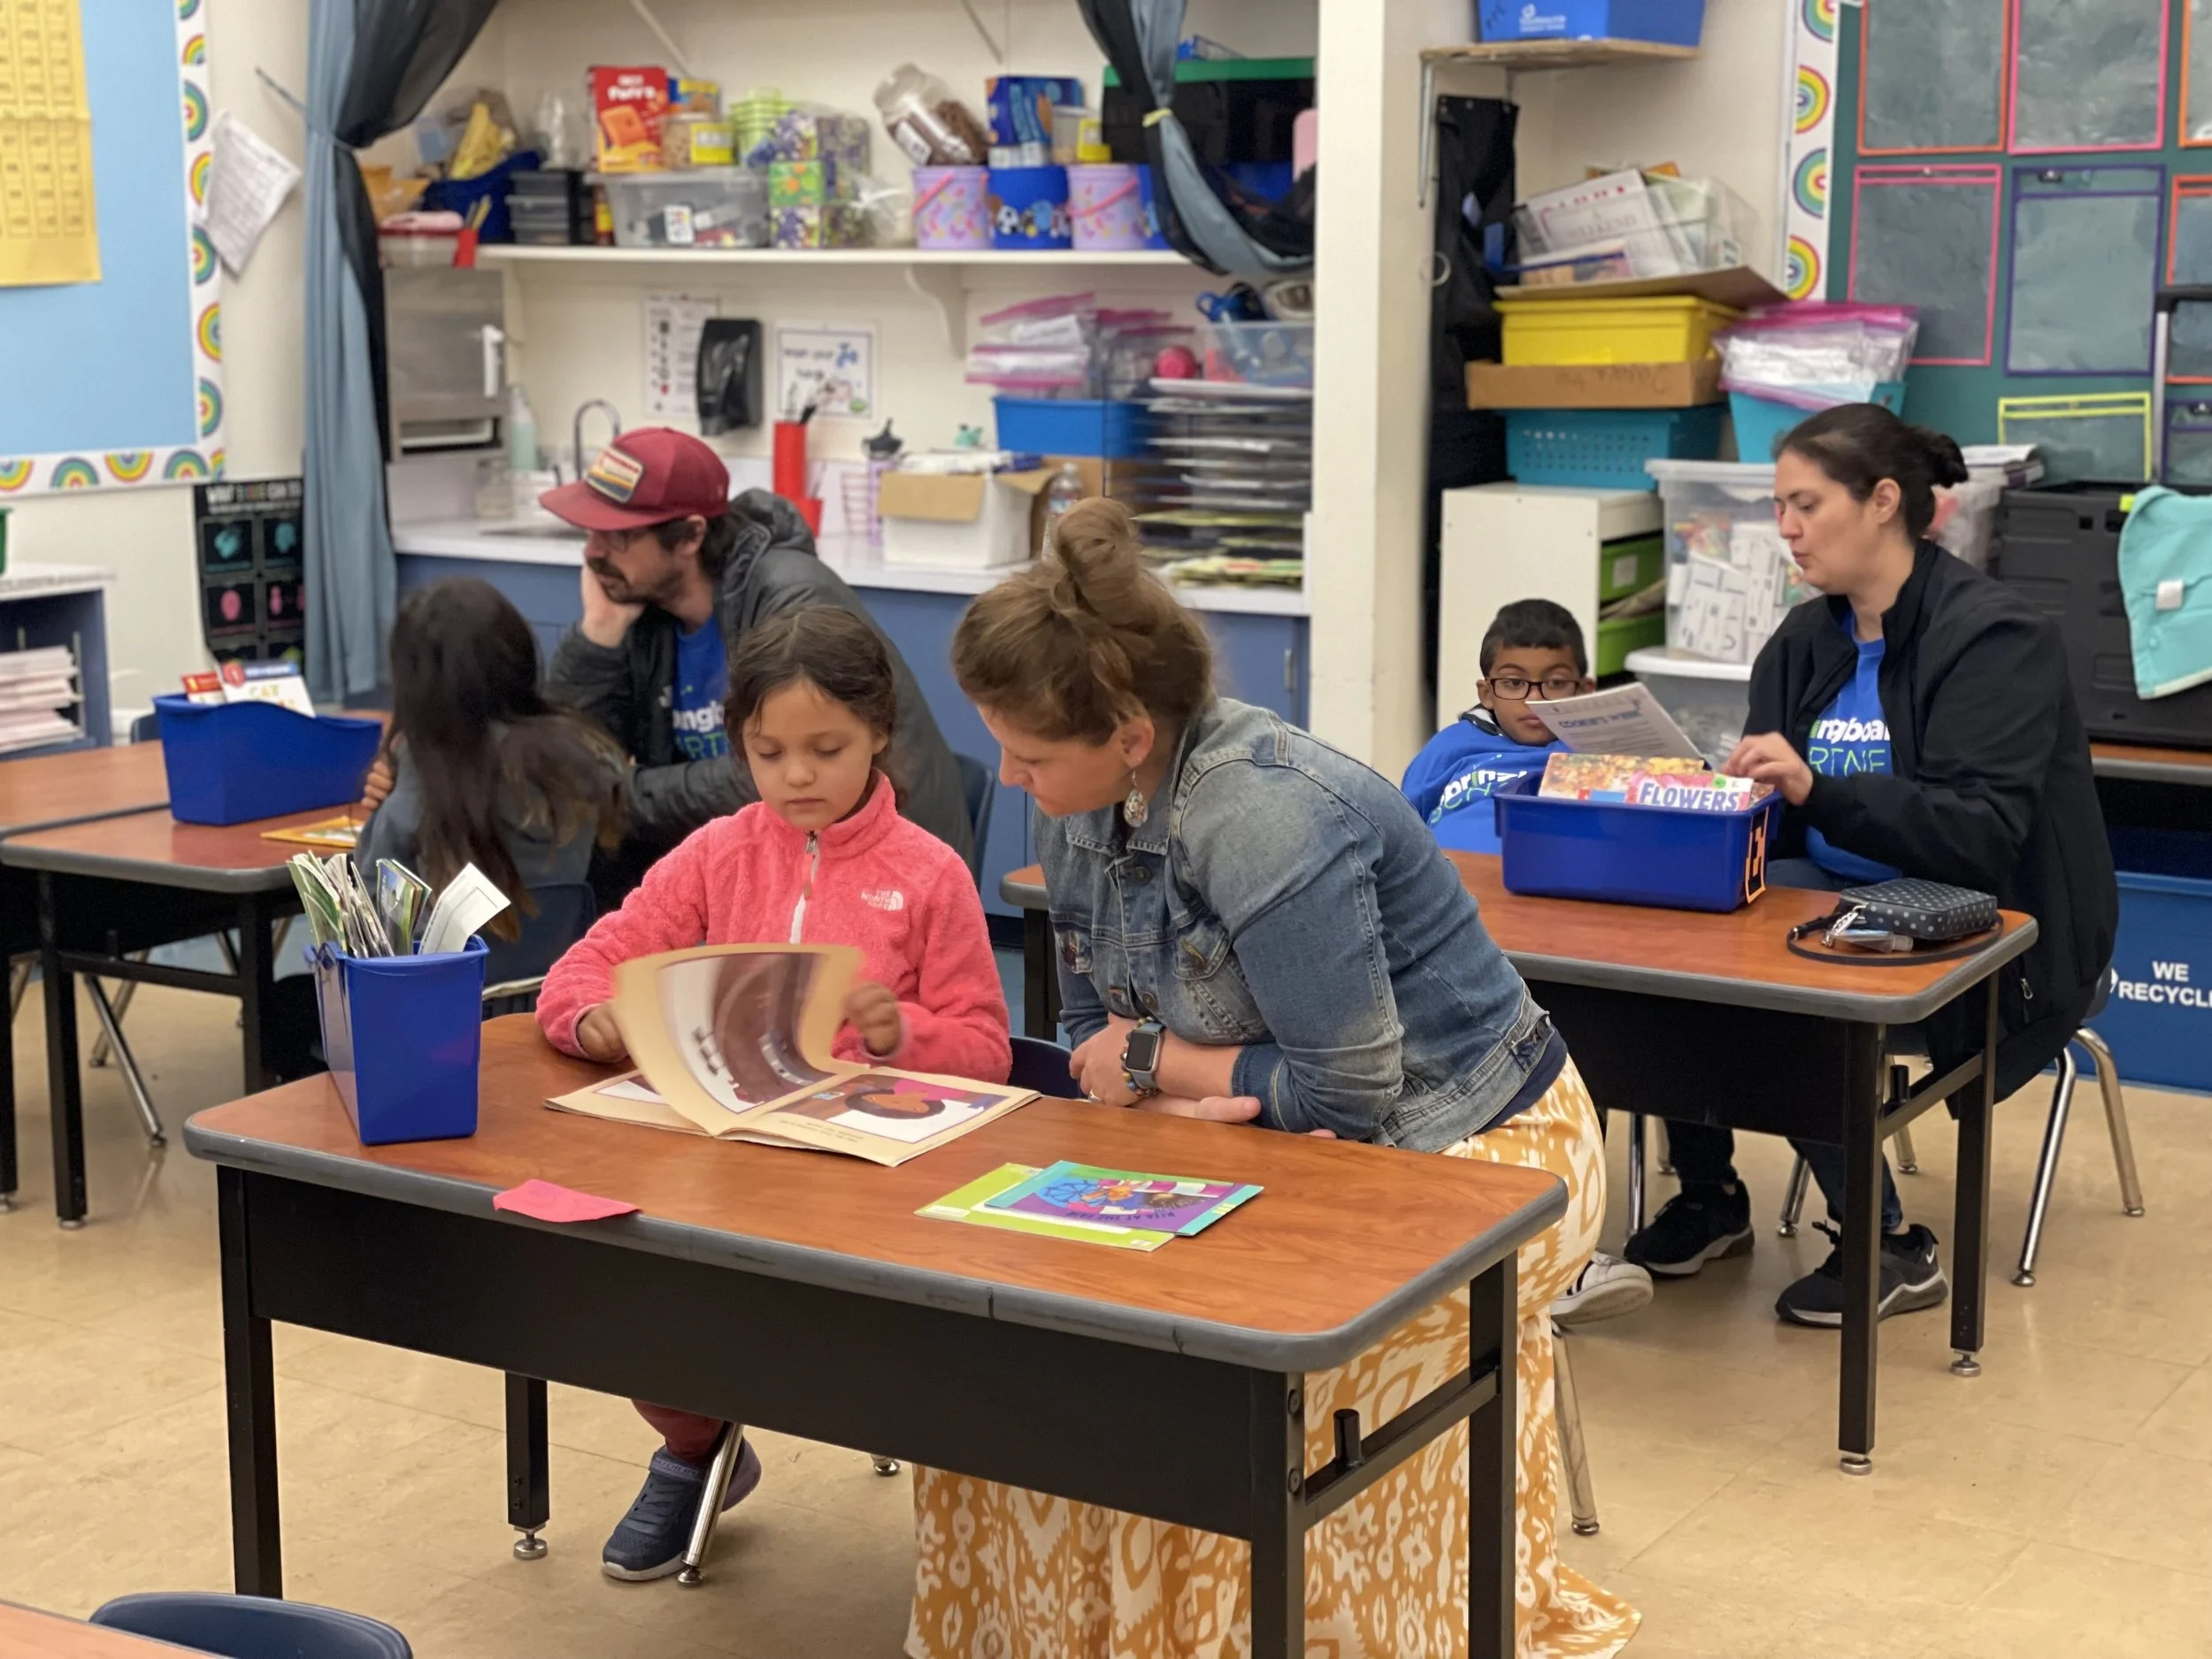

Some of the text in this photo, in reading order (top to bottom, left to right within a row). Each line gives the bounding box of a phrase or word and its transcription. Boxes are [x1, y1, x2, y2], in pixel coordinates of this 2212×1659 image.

[1639, 781, 1740, 811] FLOWERS
[2151, 960, 2190, 983] WE
[2118, 979, 2212, 1009] RECYCL
